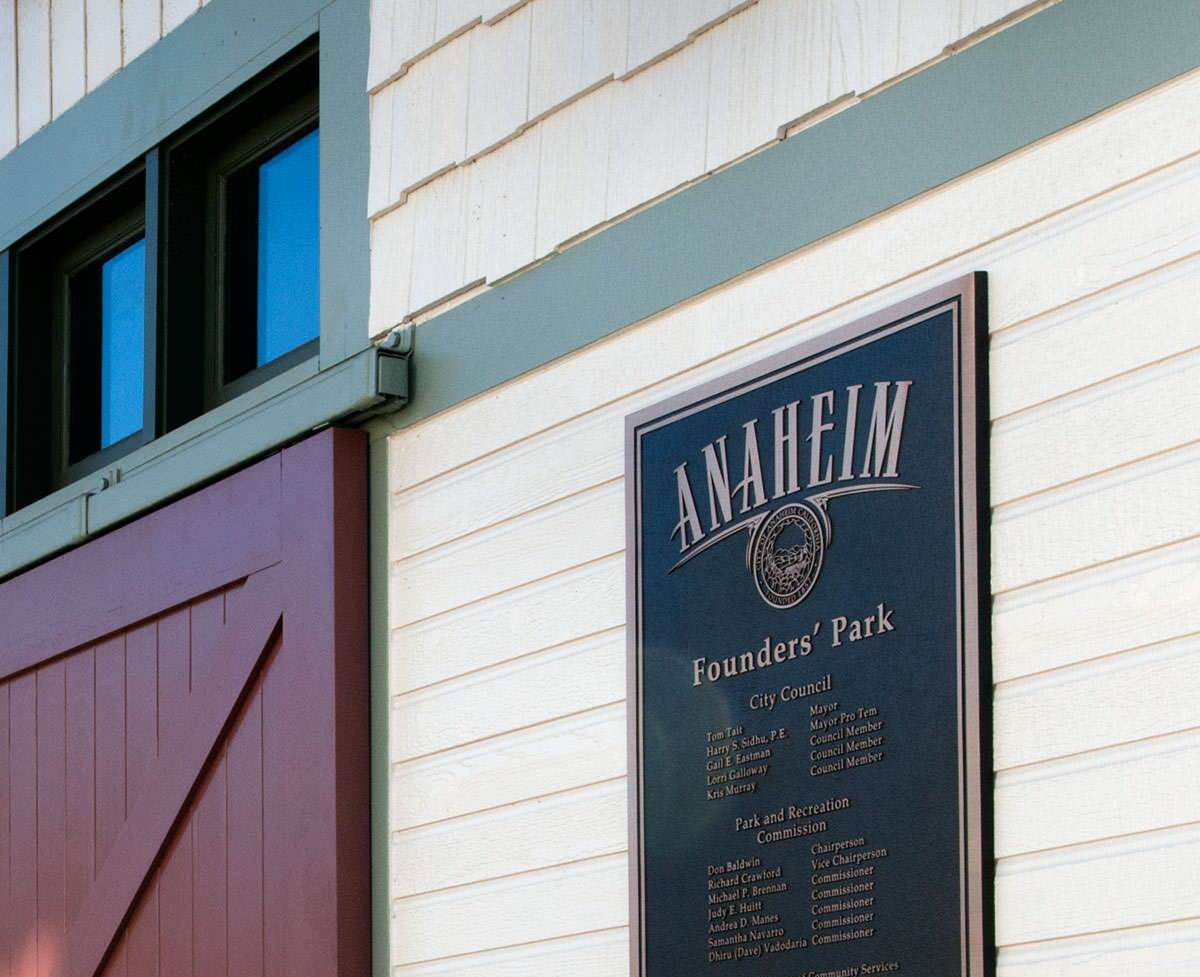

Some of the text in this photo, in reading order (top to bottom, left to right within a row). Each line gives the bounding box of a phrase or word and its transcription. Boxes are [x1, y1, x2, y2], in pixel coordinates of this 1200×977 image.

[670, 380, 912, 554] ANAHEIM
[832, 602, 895, 647] Park
[750, 675, 832, 710] City Council
[810, 701, 838, 716] Mayor
[810, 707, 877, 732] Mayor Pro Tem
[706, 725, 743, 742] Tom Tait
[810, 721, 882, 746] Council Member
[707, 743, 730, 757] Harry
[810, 736, 882, 761] Council Member
[706, 758, 723, 771] Gail
[736, 749, 771, 764] Eastman
[810, 751, 882, 776] Council Member
[729, 764, 768, 780] Galloway
[707, 782, 756, 800] Kris Murray
[736, 797, 849, 831] Park and Recreation
[757, 820, 826, 844] Commission
[811, 836, 864, 855] Chairperson
[708, 857, 760, 876] Don Baldwin
[811, 848, 887, 870] Vice Chairperson
[708, 866, 781, 890] Richard Crawford
[811, 866, 874, 885] Commissioner
[708, 889, 740, 904] Michael
[752, 882, 787, 896] Brennan
[811, 881, 874, 900] Commissioner
[708, 906, 727, 920] Judy
[811, 896, 874, 915] Commissioner
[708, 921, 738, 934] Andrea
[752, 914, 779, 926] Manes
[811, 912, 874, 930] Commissioner
[708, 928, 784, 947] Samantha Navarro
[811, 928, 874, 946] Commissioner
[708, 937, 808, 962] Dhiru (Dave) Vadodaria
[861, 961, 899, 974] Services
